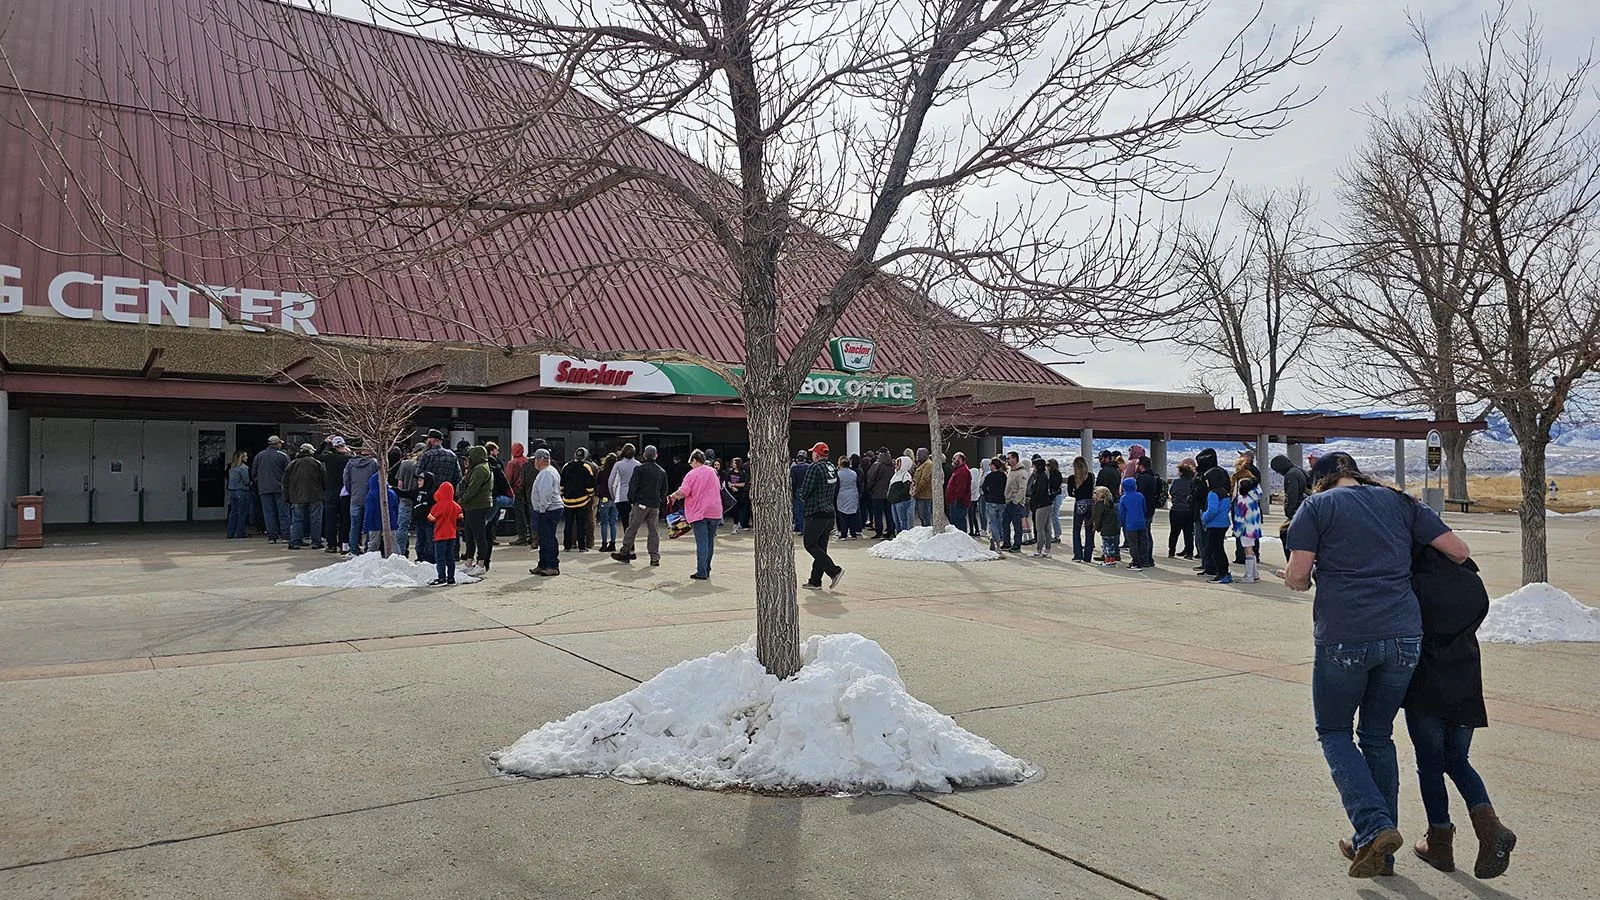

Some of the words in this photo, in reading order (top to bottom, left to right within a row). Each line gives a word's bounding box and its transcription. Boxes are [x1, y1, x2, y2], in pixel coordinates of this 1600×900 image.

[48, 271, 318, 335] CENTER
[844, 343, 871, 355] Sinclair
[554, 360, 634, 386] Sinclair
[800, 377, 841, 395] BOX
[845, 380, 913, 398] OFFICE
